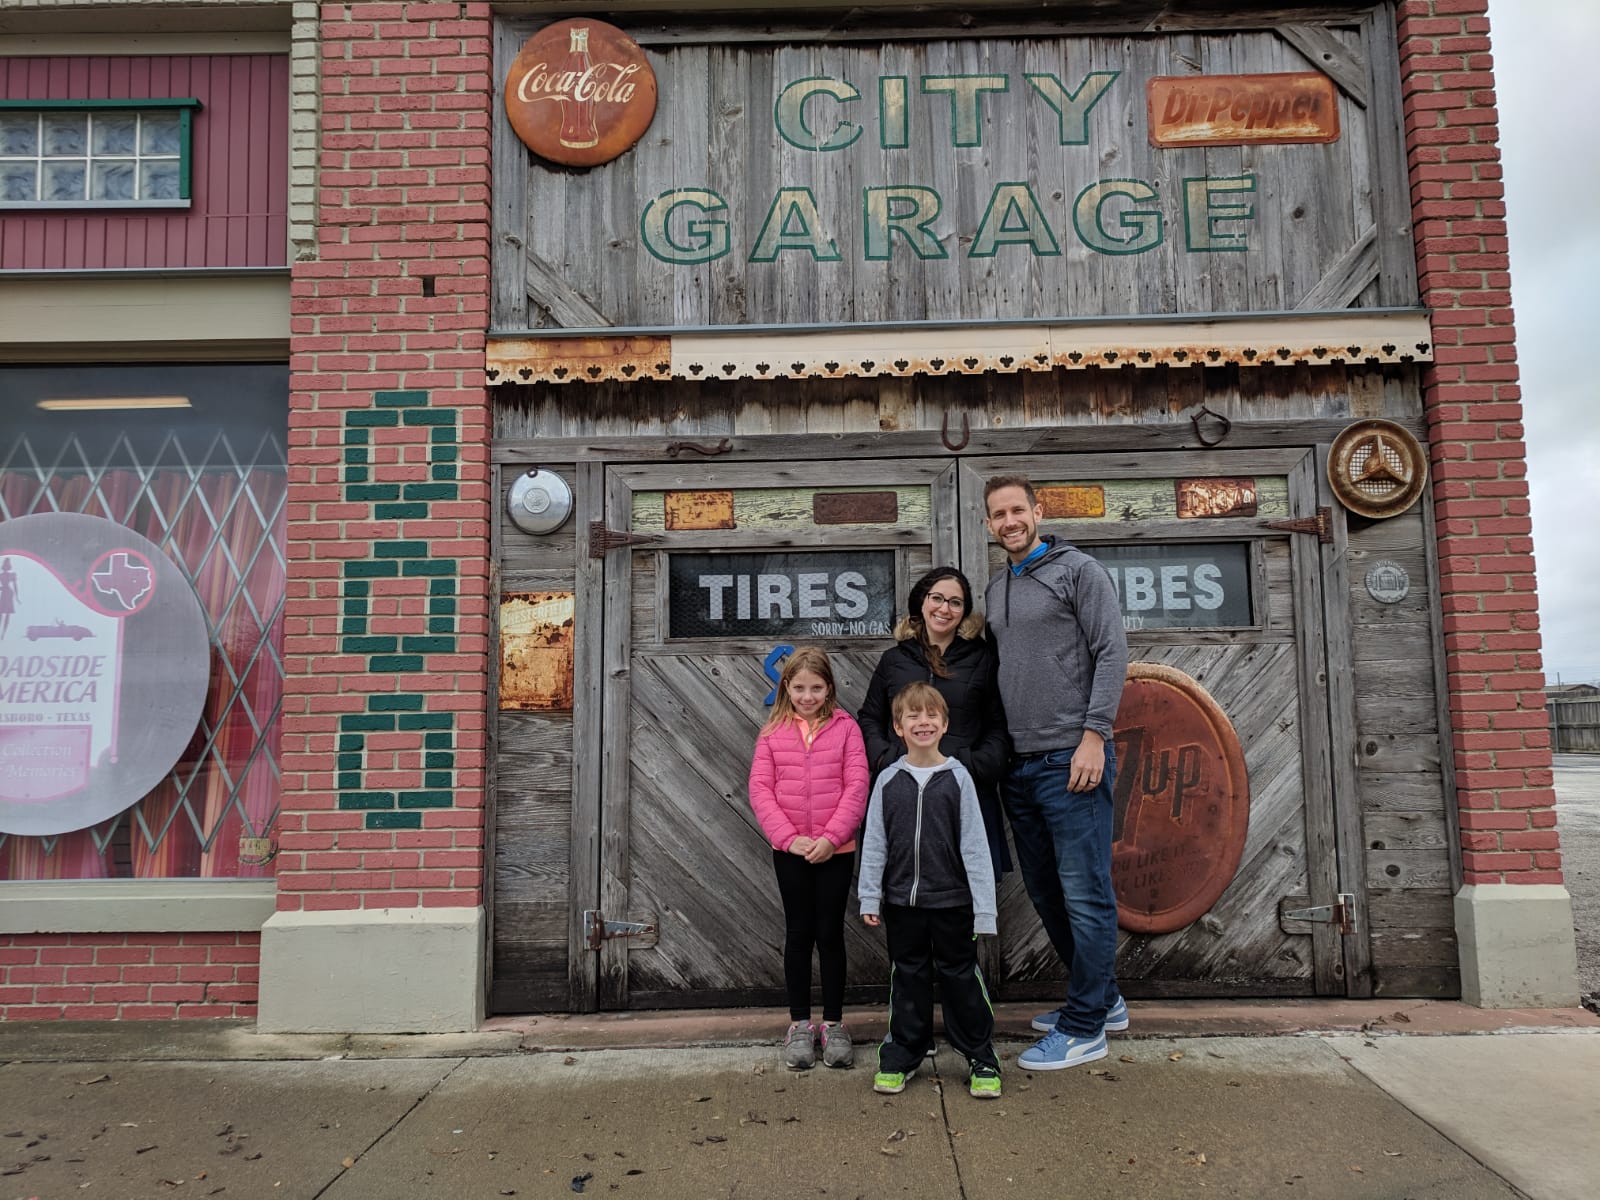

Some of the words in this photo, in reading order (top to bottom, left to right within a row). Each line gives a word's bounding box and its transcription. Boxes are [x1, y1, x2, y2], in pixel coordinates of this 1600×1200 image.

[517, 62, 641, 103] Coca-Cola
[774, 71, 1121, 152] CITY
[641, 175, 1256, 265] GARAGE
[502, 600, 573, 627] HESTERFIELD
[698, 571, 868, 620] TIRES
[869, 621, 892, 635] GAS
[56, 712, 91, 722] TEXAS
